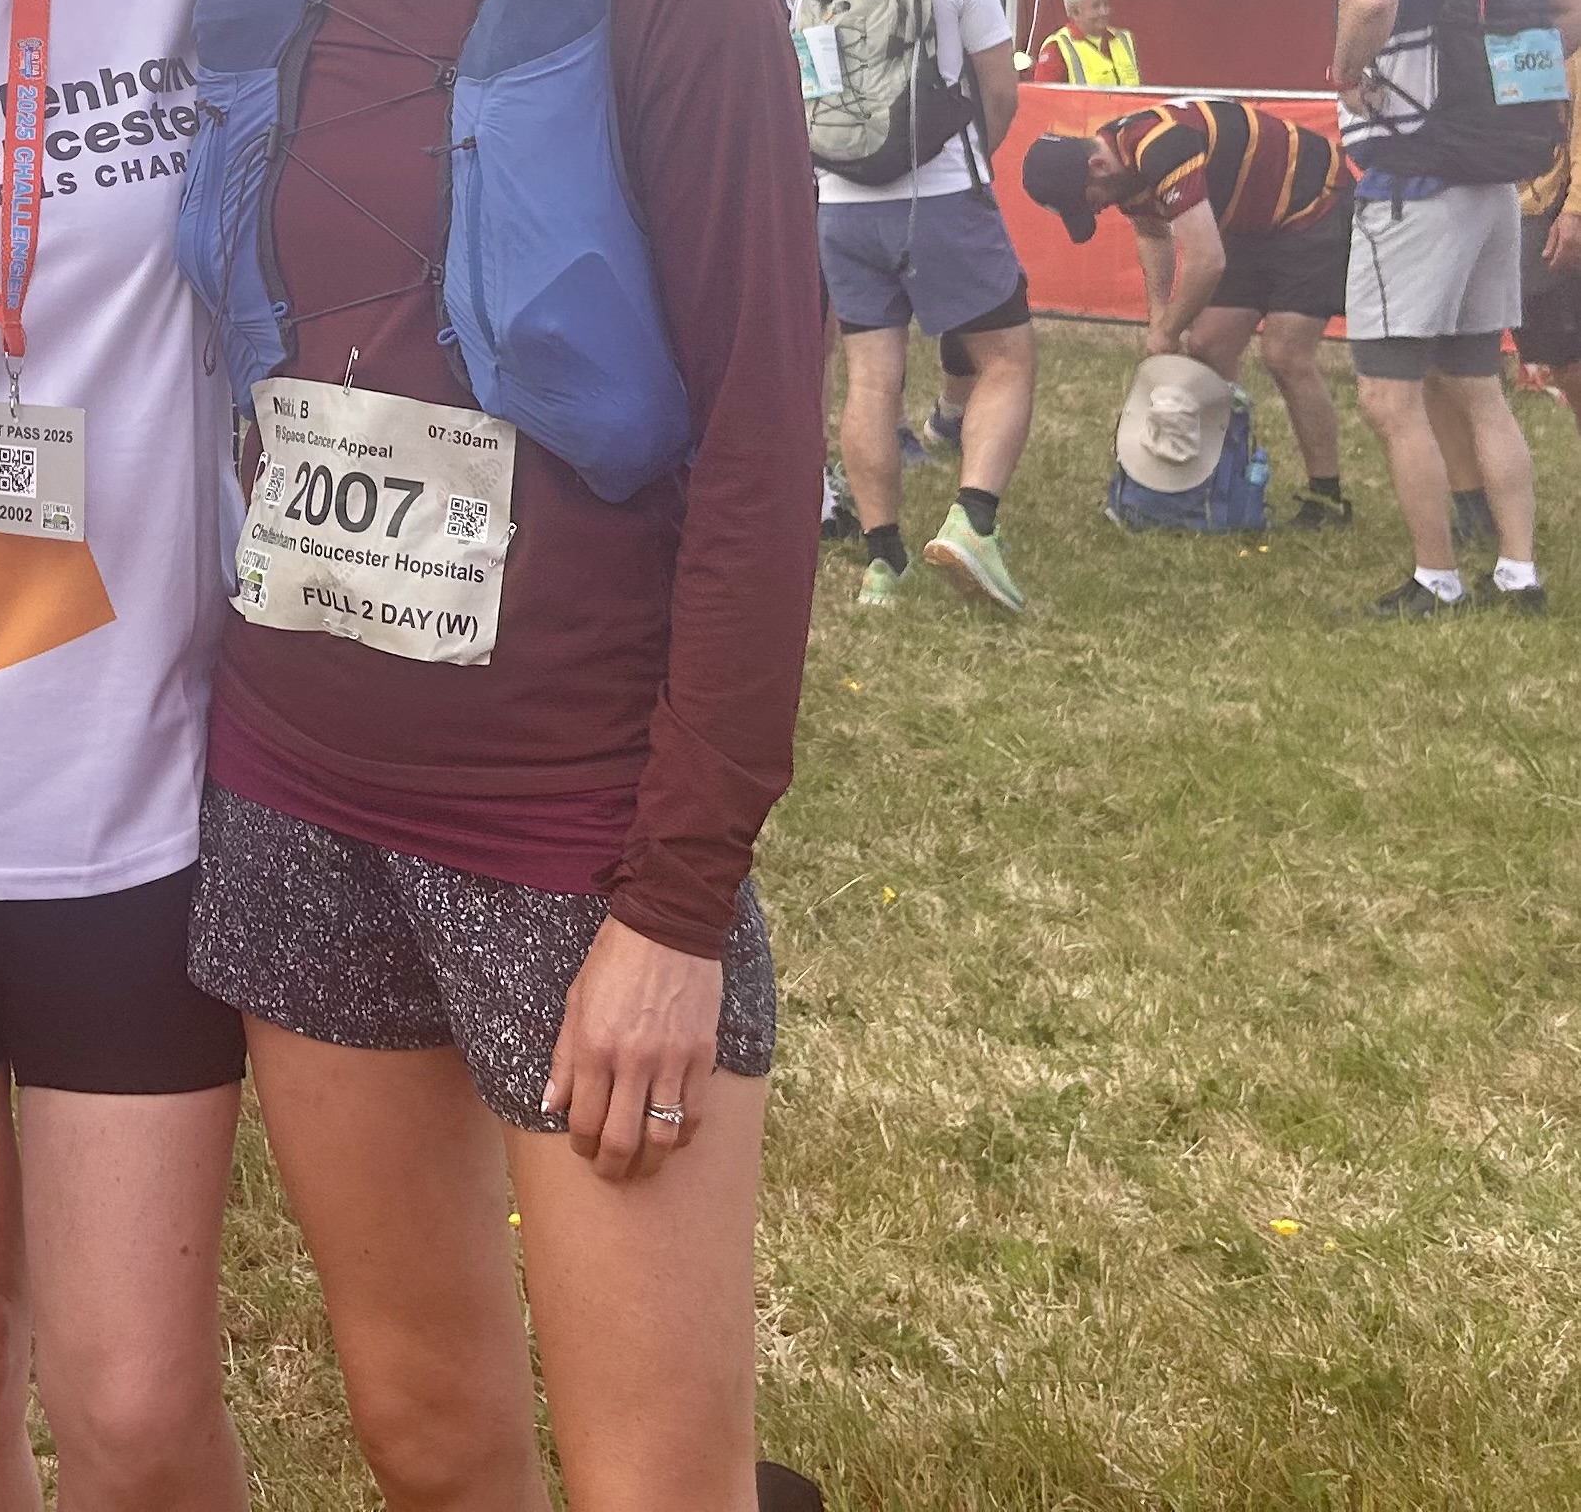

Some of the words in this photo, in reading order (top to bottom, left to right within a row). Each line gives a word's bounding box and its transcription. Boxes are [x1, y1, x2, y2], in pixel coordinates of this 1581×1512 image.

[16, 84, 38, 141] 2025
[95, 149, 192, 187] CHAR
[6, 148, 34, 310] CHALLENGER
[300, 400, 309, 419] B
[6, 425, 40, 440] PASS
[43, 429, 73, 443] 2025
[307, 430, 337, 448] Cancer
[338, 436, 392, 459] Appeal
[428, 424, 499, 451] 07:30am
[0, 505, 33, 523] 2002
[285, 461, 425, 538] 2007
[300, 531, 389, 569] Gloucester
[395, 552, 485, 583] Hopsitals
[303, 586, 357, 616] FULL
[361, 600, 374, 620] 2
[381, 604, 433, 630] DAY
[437, 611, 479, 642] (W)
